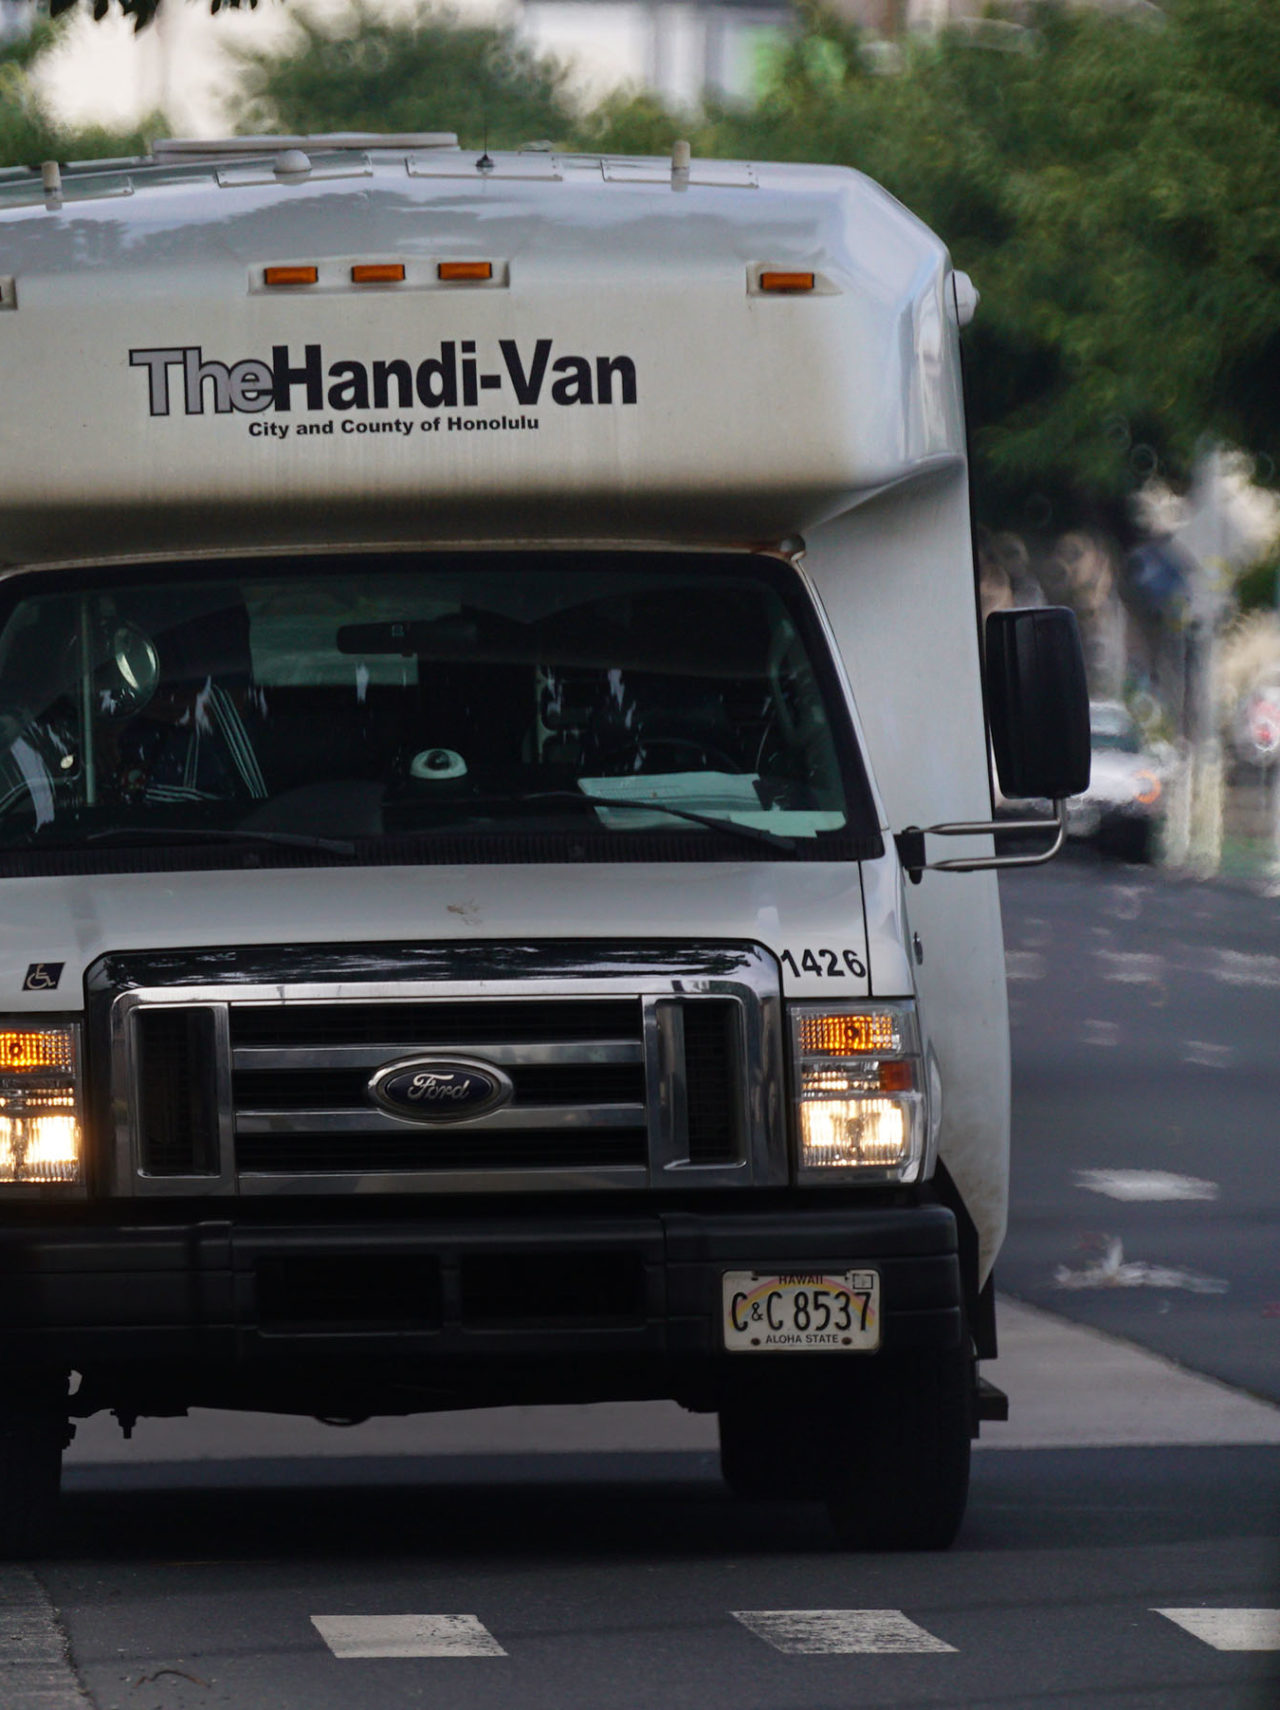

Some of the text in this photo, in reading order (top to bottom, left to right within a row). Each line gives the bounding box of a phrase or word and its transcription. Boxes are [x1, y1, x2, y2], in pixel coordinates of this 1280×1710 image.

[248, 415, 539, 439] City and County of Honolulu
[780, 948, 867, 978] 1426
[407, 1073, 471, 1100] Ford
[778, 1274, 824, 1285] HAWAII
[731, 1290, 872, 1332] C&C 8537
[765, 1333, 839, 1345] ALOHA STATE
